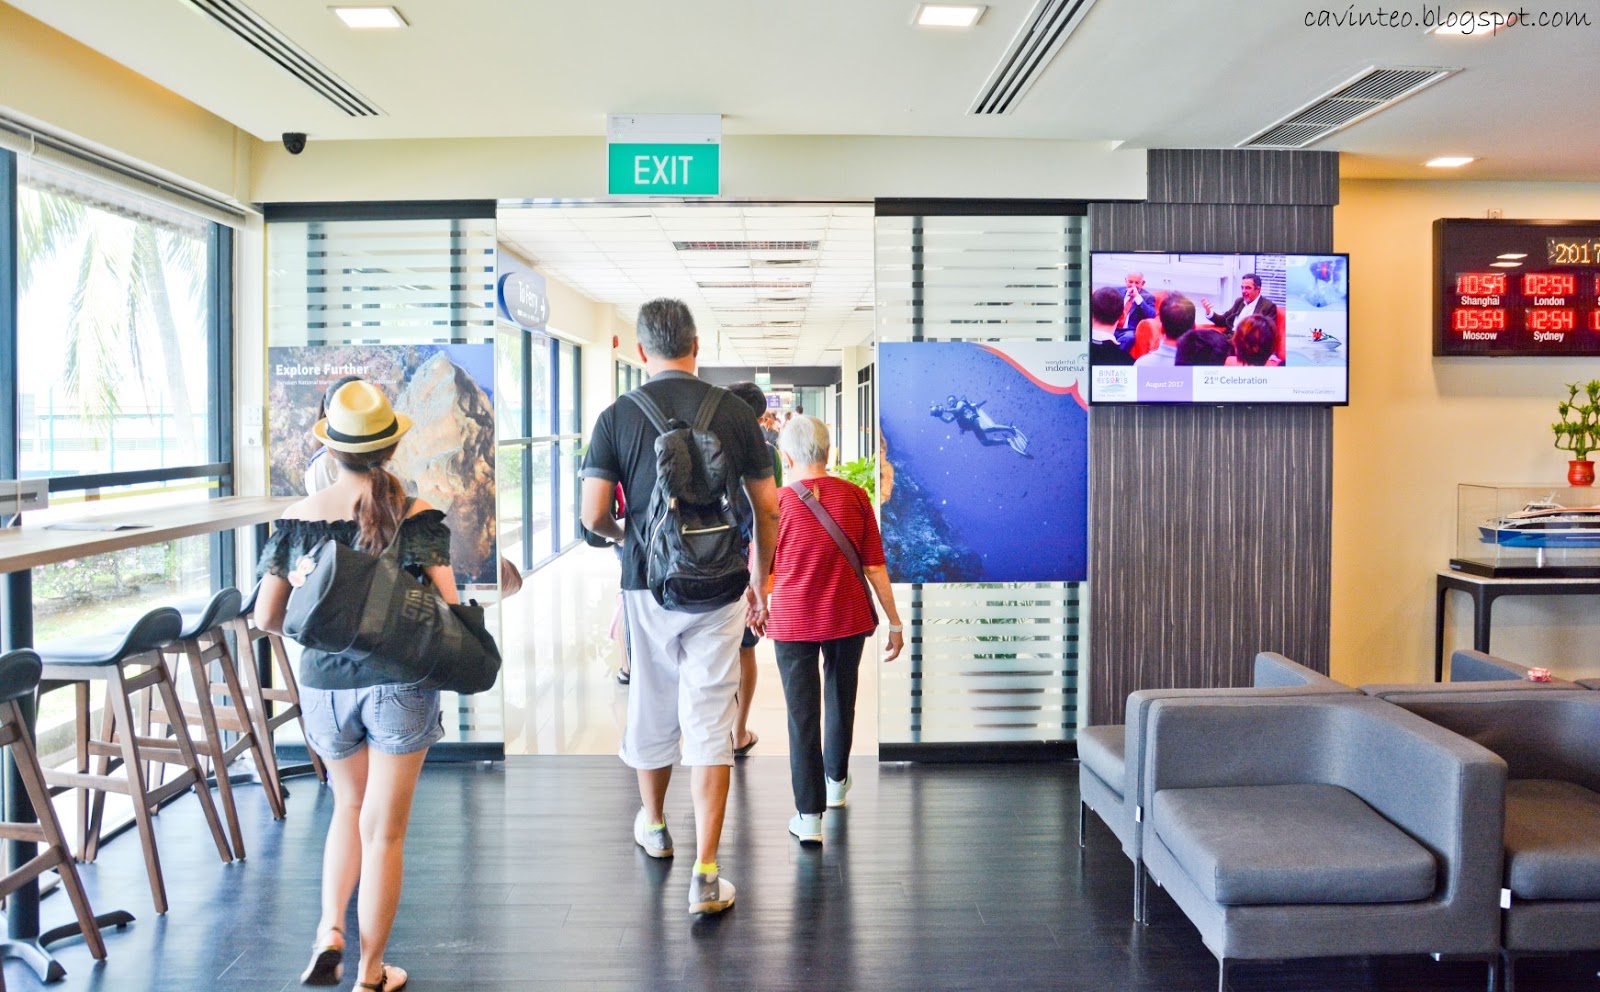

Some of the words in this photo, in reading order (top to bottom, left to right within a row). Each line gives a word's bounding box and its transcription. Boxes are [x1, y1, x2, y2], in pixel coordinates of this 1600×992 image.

[634, 155, 694, 185] EXIT
[1526, 275, 1574, 295] 02:54
[518, 280, 526, 304] To
[1461, 295, 1500, 307] Shanghai
[1534, 296, 1565, 306] London
[1531, 310, 1574, 329] 12:54
[1462, 330, 1497, 340] Moscow
[1533, 330, 1564, 342] Sydney
[275, 364, 321, 378] Explore
[323, 363, 370, 375] Further
[1045, 364, 1085, 372] indonesia
[1145, 381, 1167, 389] August
[1220, 376, 1268, 385] Celebration
